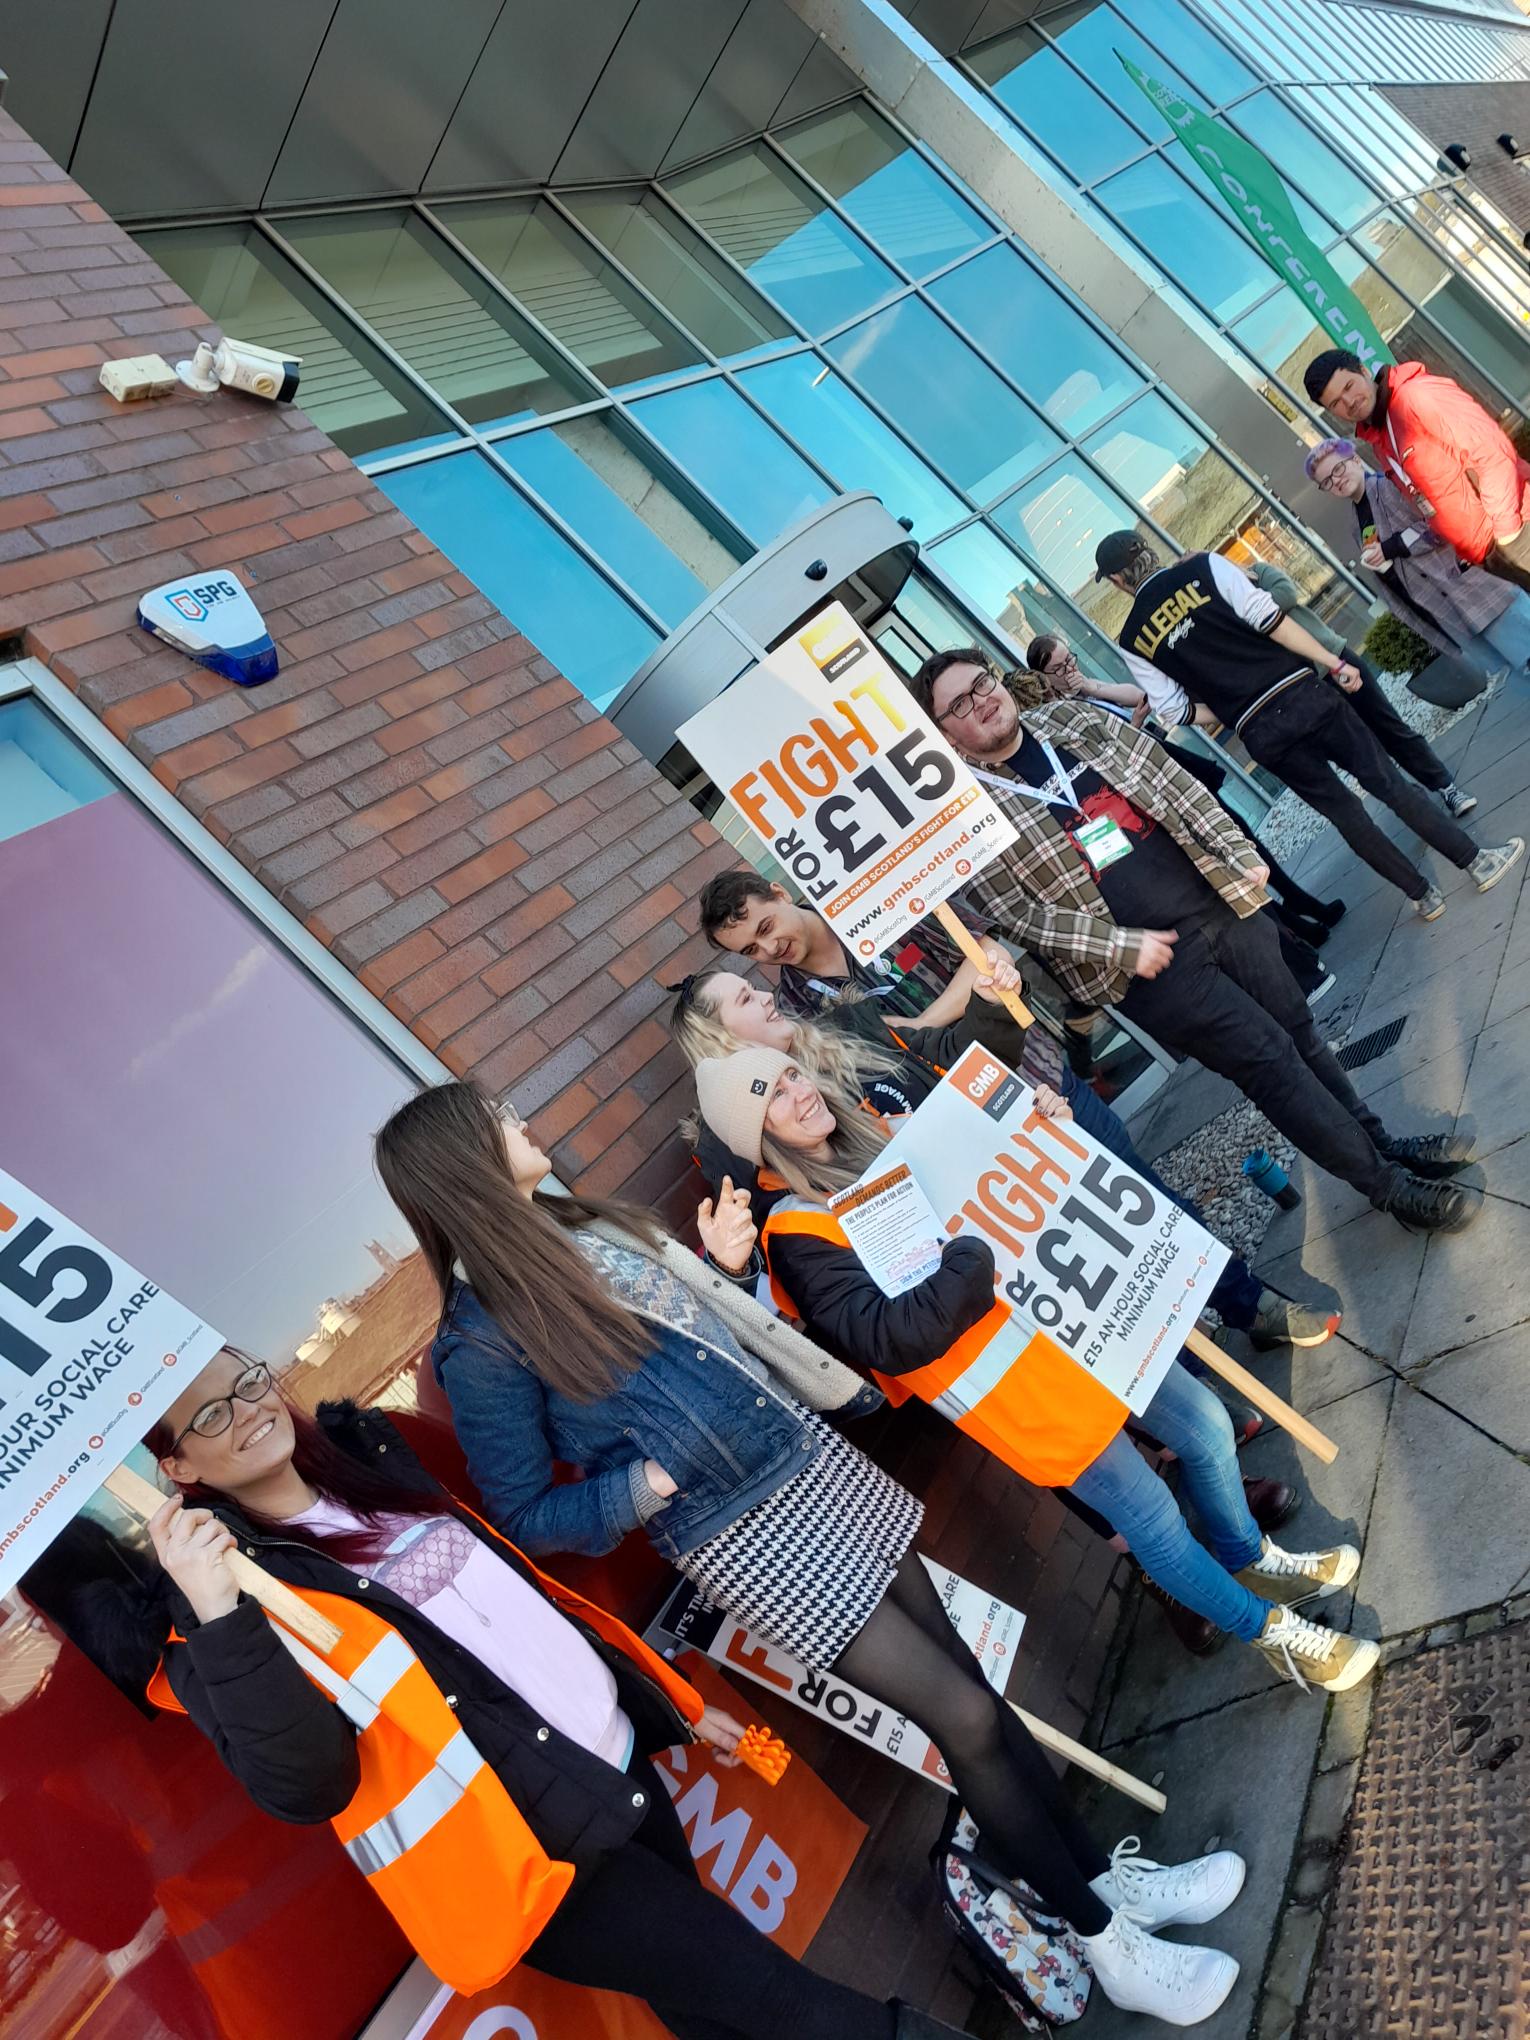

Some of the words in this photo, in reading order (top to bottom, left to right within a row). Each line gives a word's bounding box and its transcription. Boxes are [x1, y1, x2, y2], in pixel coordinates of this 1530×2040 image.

[193, 581, 237, 604] SPG
[1134, 583, 1211, 659] ILLEGAL
[729, 672, 907, 840] FIGHT
[815, 728, 955, 874] £15
[774, 827, 838, 902] FOR
[830, 895, 851, 914] JOIN
[850, 878, 871, 896] GMB
[870, 836, 921, 881] SCOTLAND'S
[920, 816, 945, 840] FIGHT
[944, 803, 963, 820] FOR
[845, 811, 997, 938] www.gmbscotland.org
[874, 1082, 905, 1104] WAGE
[968, 1063, 999, 1098] GMB
[992, 1083, 1015, 1111] SCOTLAND
[833, 1183, 864, 1208] SCOTLAND
[854, 1205, 876, 1221] PEOPLE'S
[874, 1197, 889, 1209] PLAN
[896, 1181, 914, 1199] ACTION
[855, 1183, 885, 1206] DEMANDS
[883, 1170, 907, 1190] BETTER
[1036, 1154, 1156, 1312] £15
[1005, 1269, 1088, 1349] FOR
[1083, 1340, 1103, 1367] £15
[1099, 1319, 1116, 1345] AN
[1110, 1281, 1140, 1321] HOUR
[1133, 1239, 1165, 1282] SOCIAL
[1160, 1205, 1184, 1238] CARE
[1116, 1278, 1158, 1341] MINIMUM
[1152, 1240, 1180, 1280] WAGE
[35, 1338, 111, 1412] SOCIAL
[106, 1281, 160, 1334] CARE
[69, 1337, 135, 1401] WAGE
[1124, 1312, 1177, 1398] www.gmbscotland.org
[674, 1611, 695, 1638] IT'S
[797, 1669, 882, 1739] FOR
[886, 1729, 904, 1755] £15
